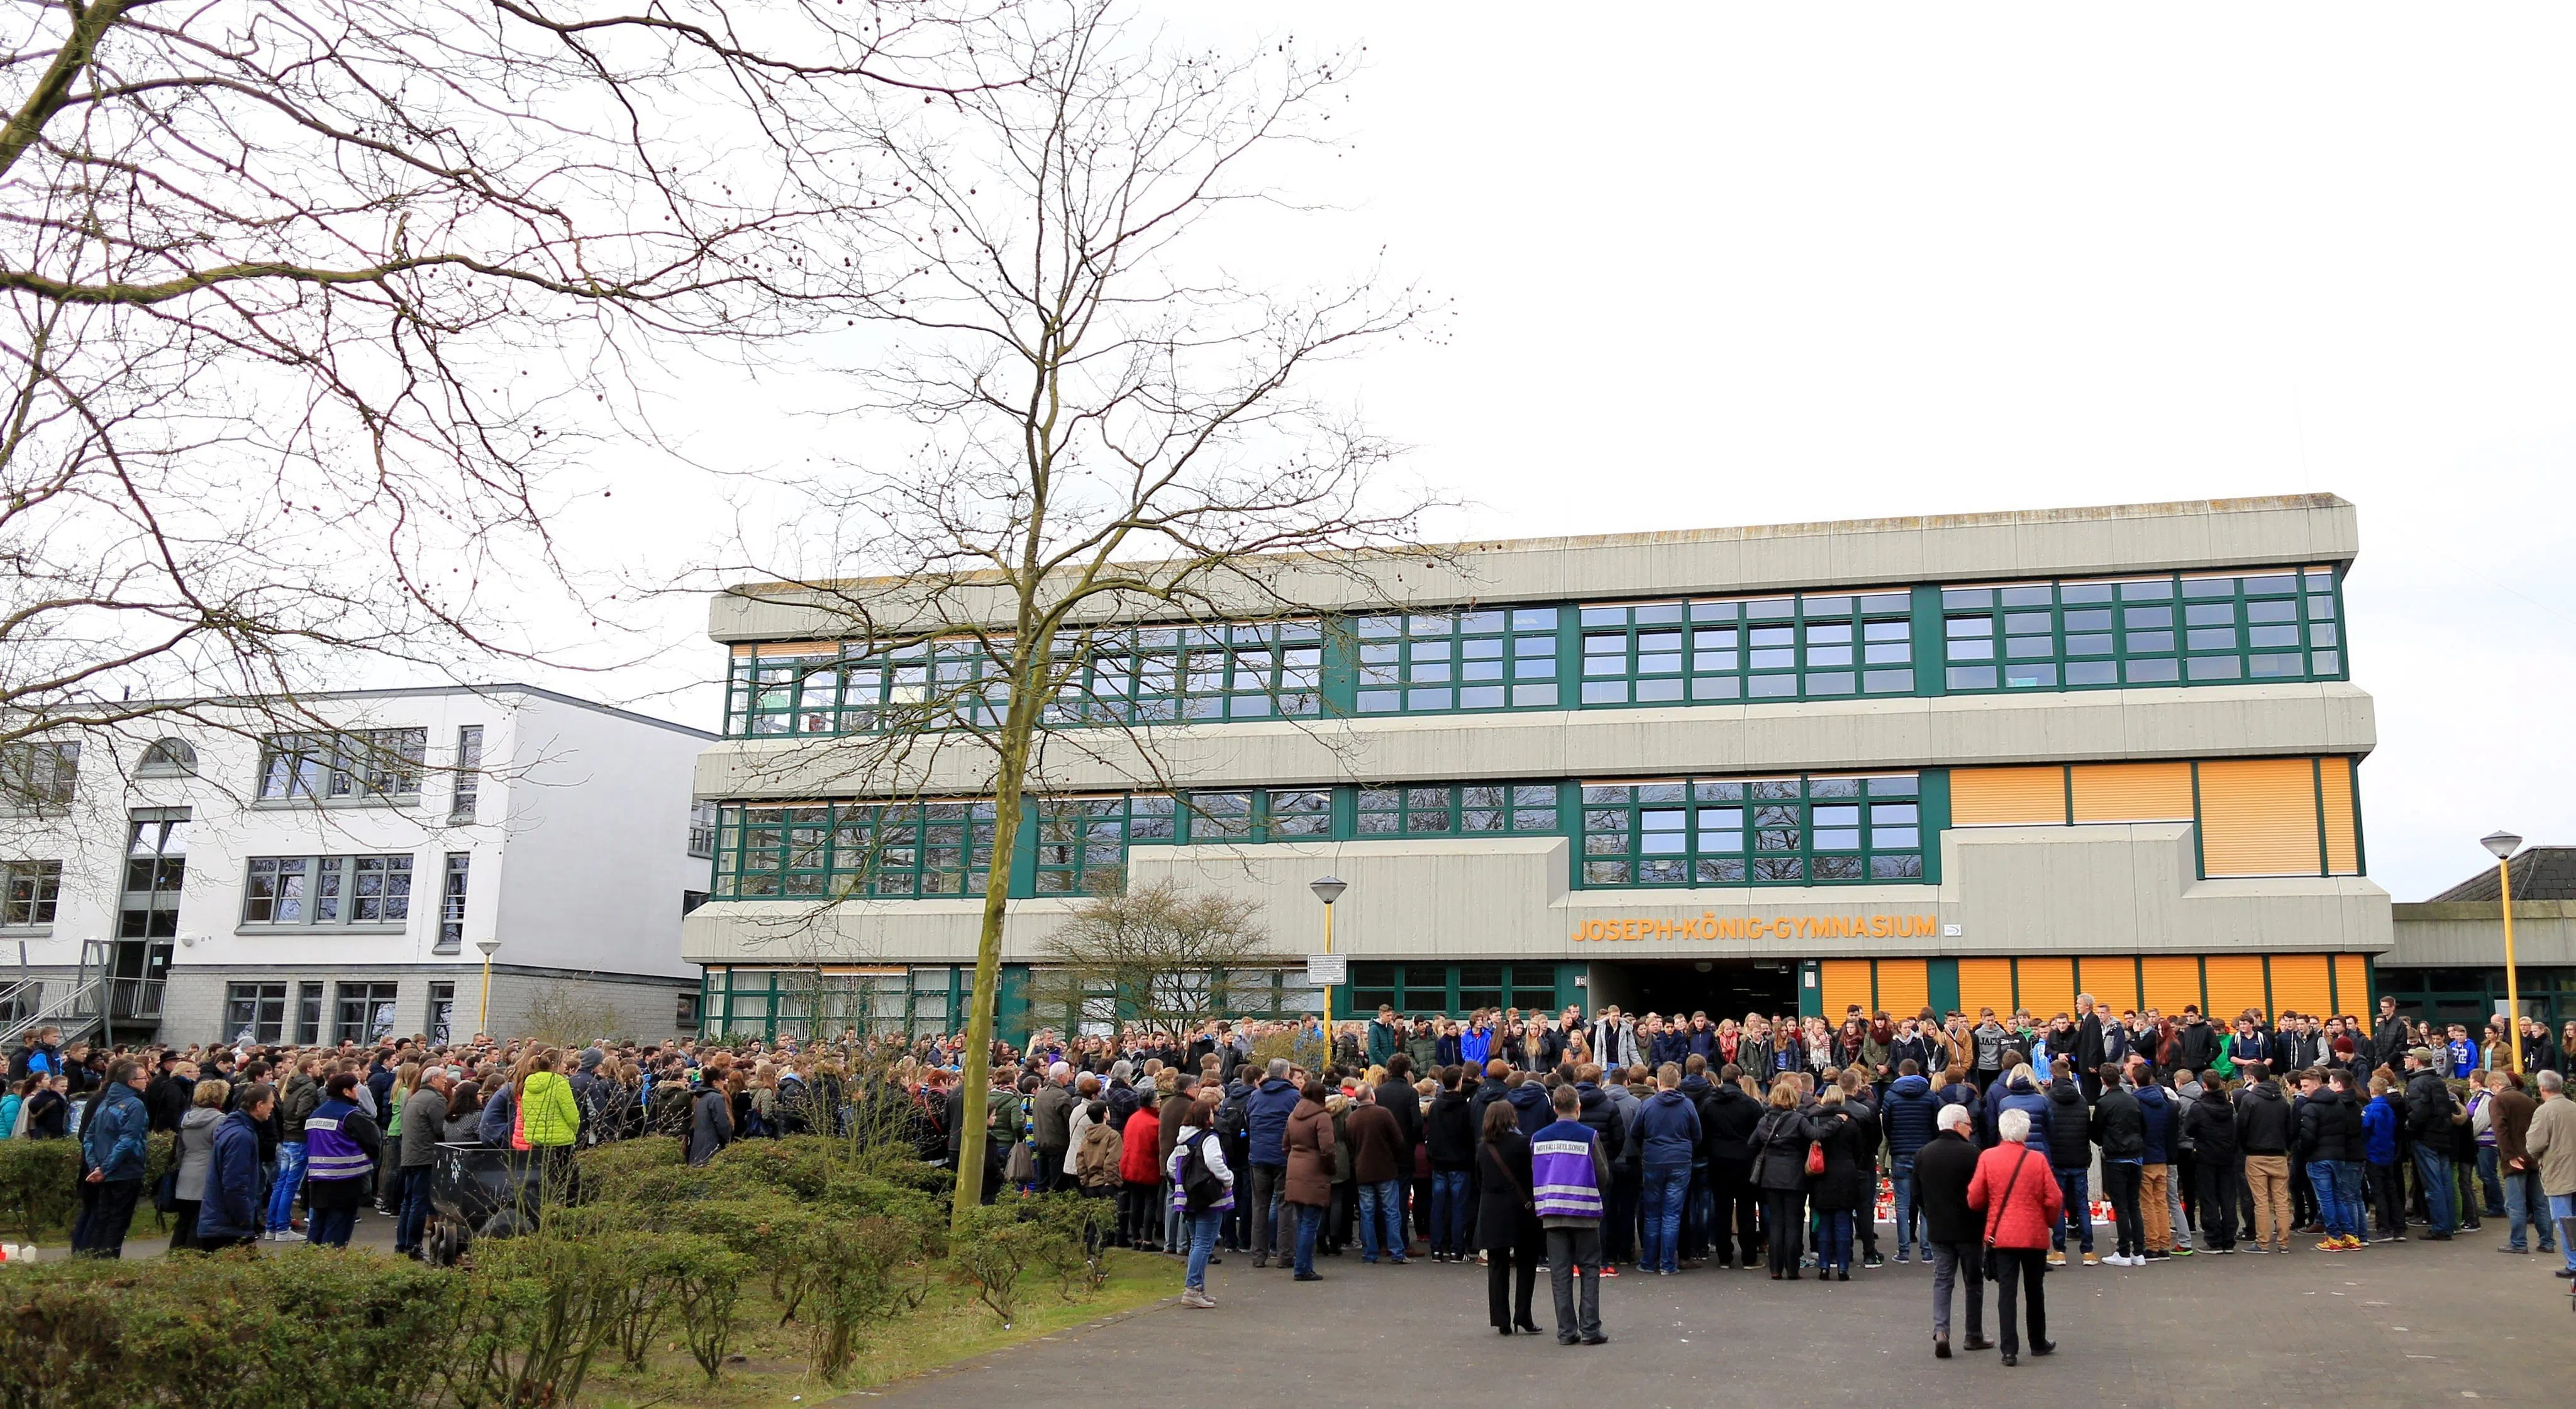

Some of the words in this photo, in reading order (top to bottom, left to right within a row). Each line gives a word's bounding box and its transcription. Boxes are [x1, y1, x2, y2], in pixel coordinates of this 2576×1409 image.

[1572, 912, 1935, 941] JOSEPH-KÖNIG-GYMNASIUM
[1980, 1037, 1999, 1045] JAC
[1536, 1143, 1586, 1152] NOTFALLSEELSORGE
